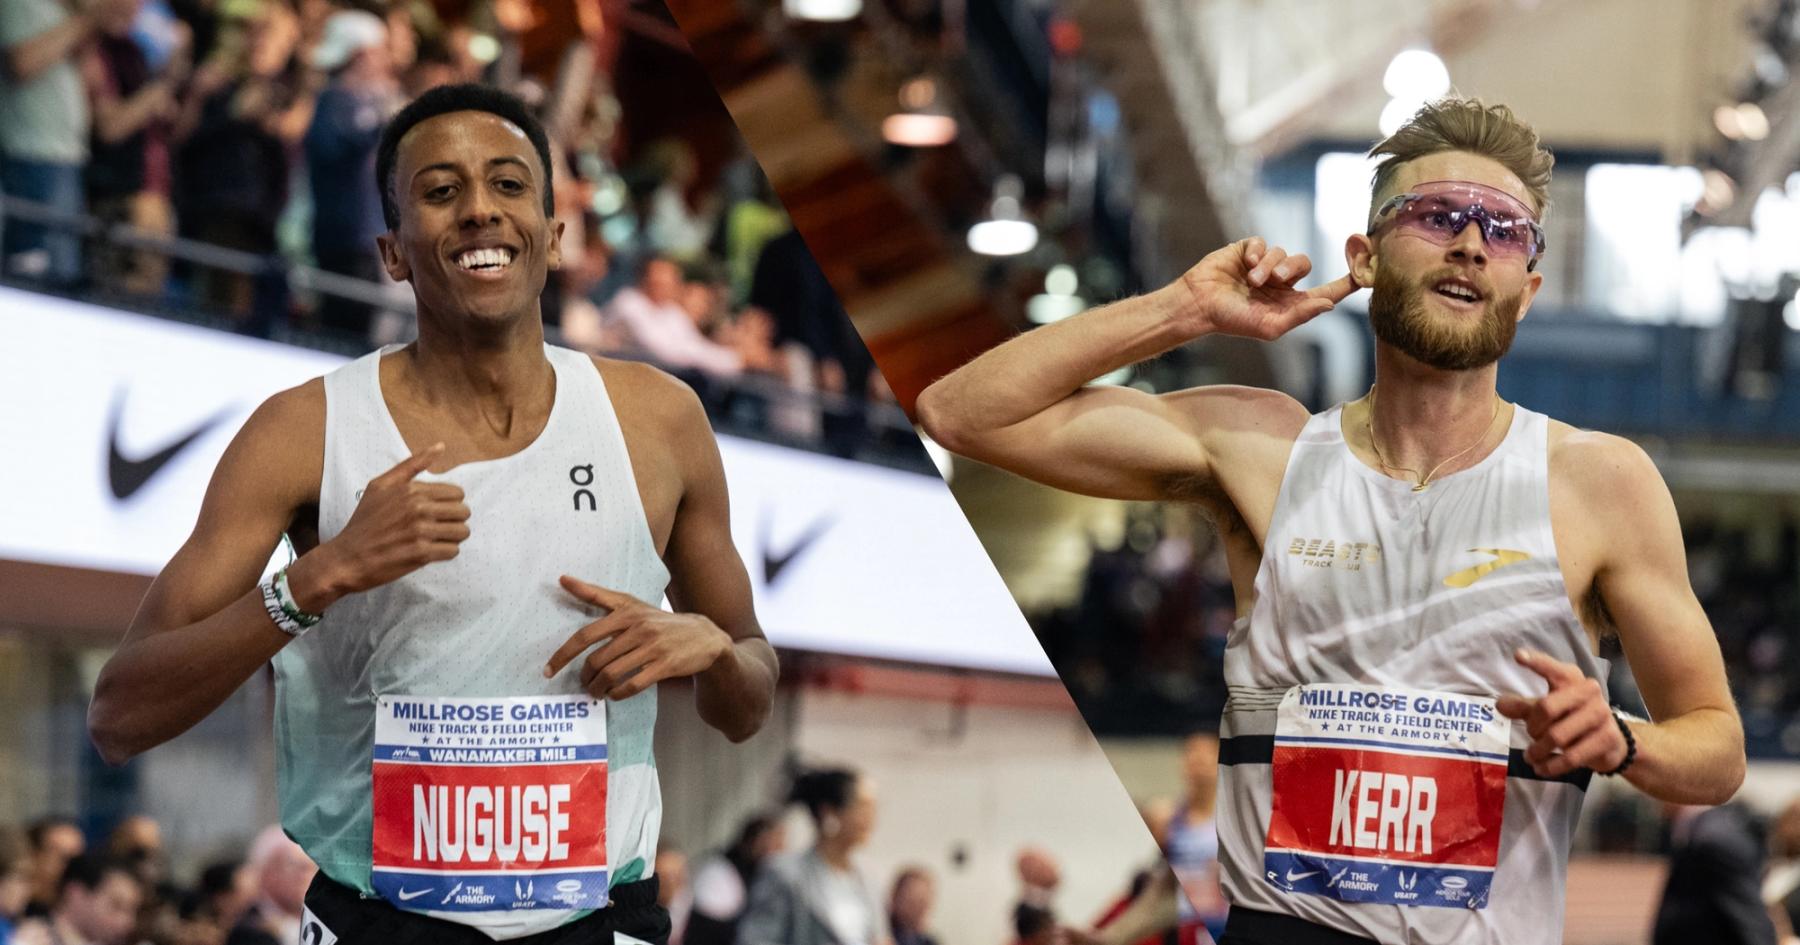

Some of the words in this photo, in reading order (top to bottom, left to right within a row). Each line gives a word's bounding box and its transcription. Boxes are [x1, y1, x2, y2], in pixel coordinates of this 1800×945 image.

[1303, 560, 1333, 568] TRACK
[393, 701, 504, 721] MILLROSE
[510, 701, 590, 720] GAMES
[1300, 690, 1408, 712] MILLROSE
[1413, 697, 1494, 722] GAMES
[1309, 709, 1338, 720] NIKE
[1341, 710, 1380, 723] TRACK
[1384, 713, 1391, 724] &
[1396, 715, 1431, 728] FIELD
[1435, 718, 1483, 734] CENTER
[409, 722, 436, 734] NIKE
[438, 722, 478, 734] TRACK
[481, 723, 490, 734] &
[493, 723, 527, 734] FIELD
[530, 722, 574, 733] CENTER
[1337, 724, 1353, 733] AT
[1359, 724, 1385, 735] THE
[1391, 728, 1451, 742] ARMORY
[436, 736, 450, 745] AT
[458, 737, 484, 746] THE
[489, 736, 545, 746] ARMORY
[429, 748, 537, 762] WANAMAKER
[540, 748, 576, 760] MILE
[1328, 769, 1438, 855] KERR
[413, 784, 571, 863] NUGUSE
[1351, 872, 1369, 882] THE
[466, 886, 484, 895] THE
[1338, 881, 1379, 892] ARMORY
[455, 894, 496, 904] ARMORY
[1394, 891, 1419, 900] USATF
